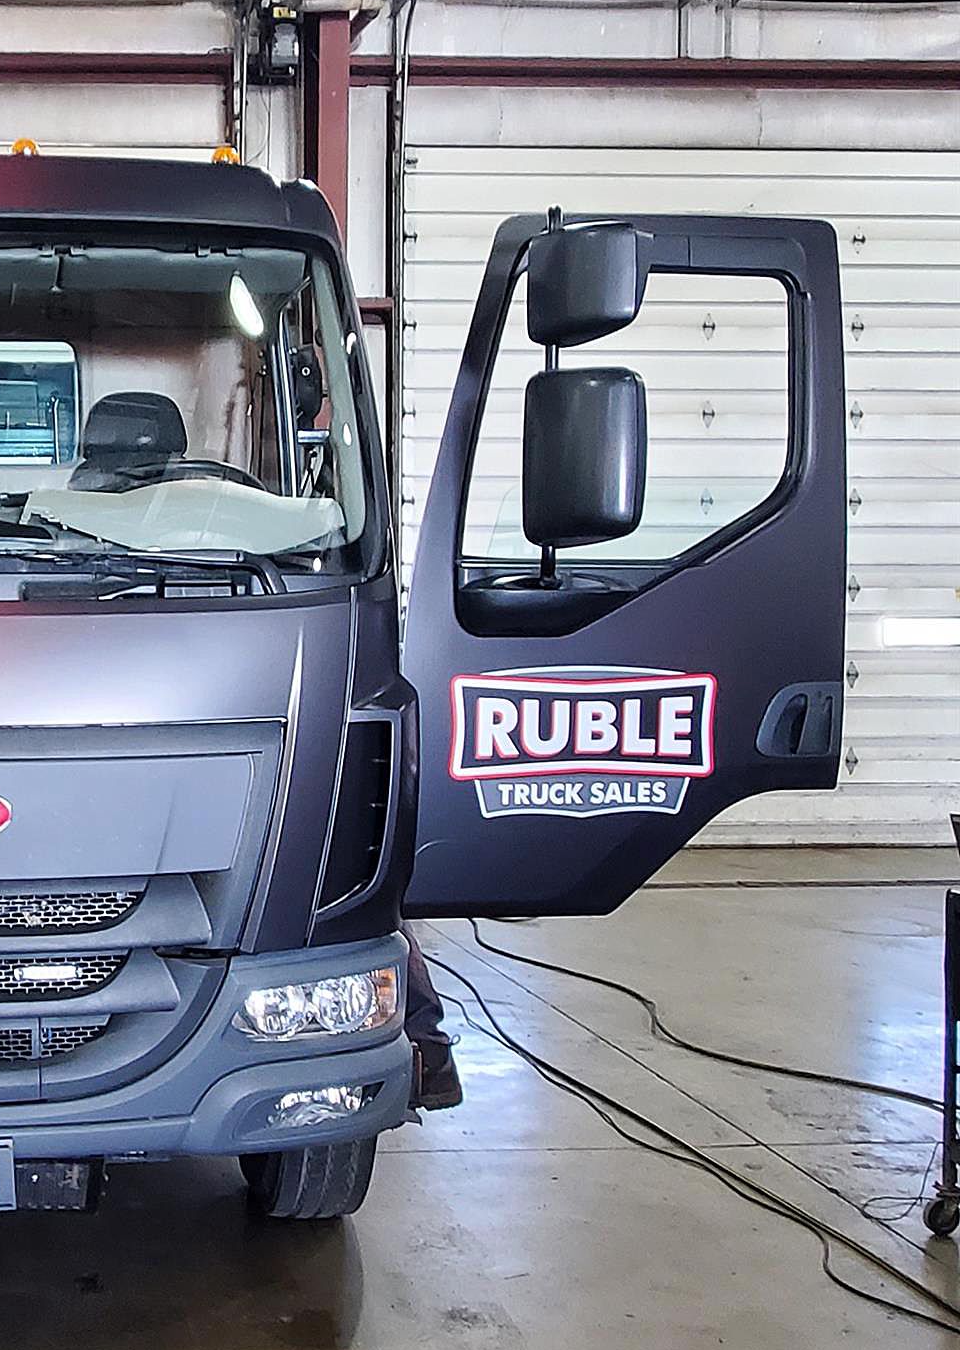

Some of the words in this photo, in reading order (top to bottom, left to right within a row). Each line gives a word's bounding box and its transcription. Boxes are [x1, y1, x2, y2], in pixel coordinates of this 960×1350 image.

[475, 695, 694, 760] RUBLE
[498, 782, 583, 806] TRUCK
[590, 780, 668, 805] SALES
